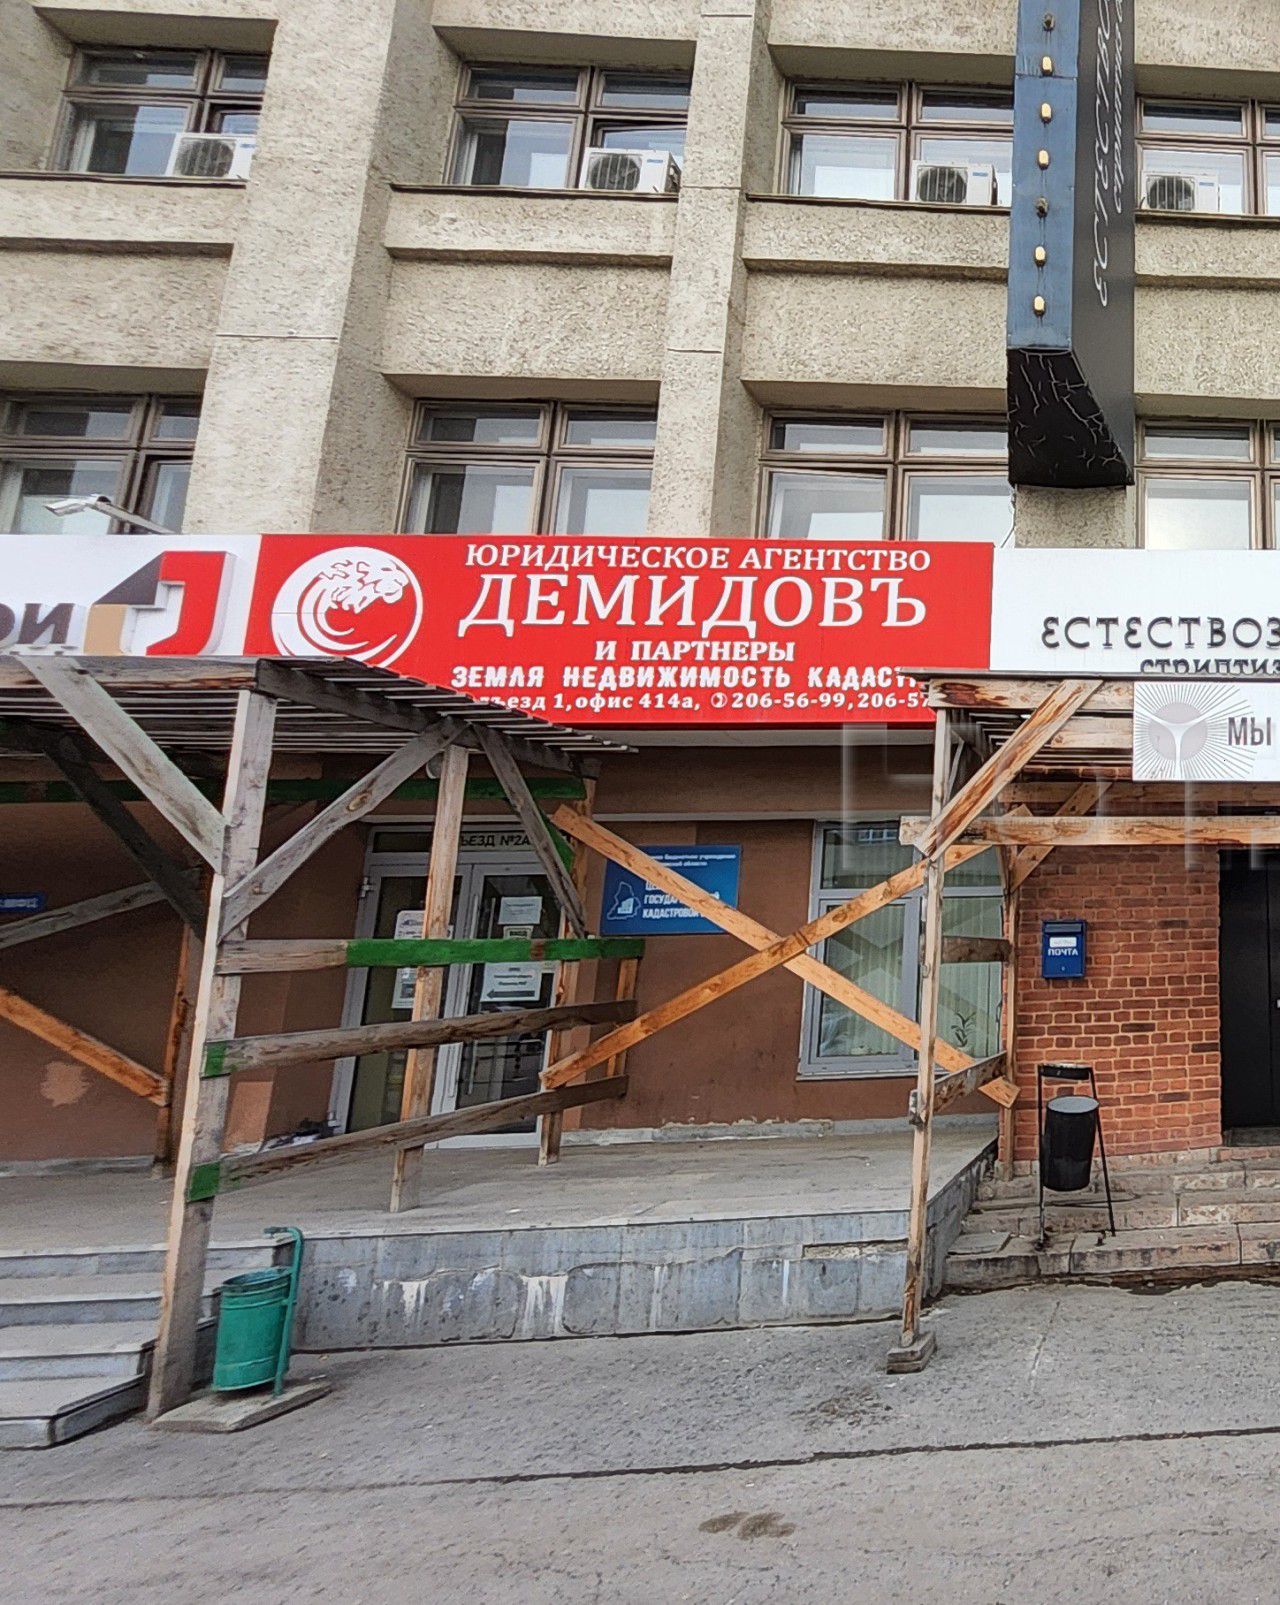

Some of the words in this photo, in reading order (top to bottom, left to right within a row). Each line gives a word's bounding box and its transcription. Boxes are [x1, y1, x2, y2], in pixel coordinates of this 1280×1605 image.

[465, 544, 730, 571] ЮРИДИЧЕСКОЕ
[737, 548, 931, 572] АГЕНТСТВО
[457, 573, 928, 638] ДЕМИДОВЪ
[594, 640, 617, 661] И
[630, 640, 796, 662] ПАРТНЕРЫ
[450, 665, 545, 688] ЗЕМЛЯ
[562, 665, 791, 692] НЕДВИЖИМОСТЬ
[638, 692, 701, 711] 414а,
[1227, 716, 1272, 747] МЫ
[1047, 948, 1079, 956] ПОЧТА
